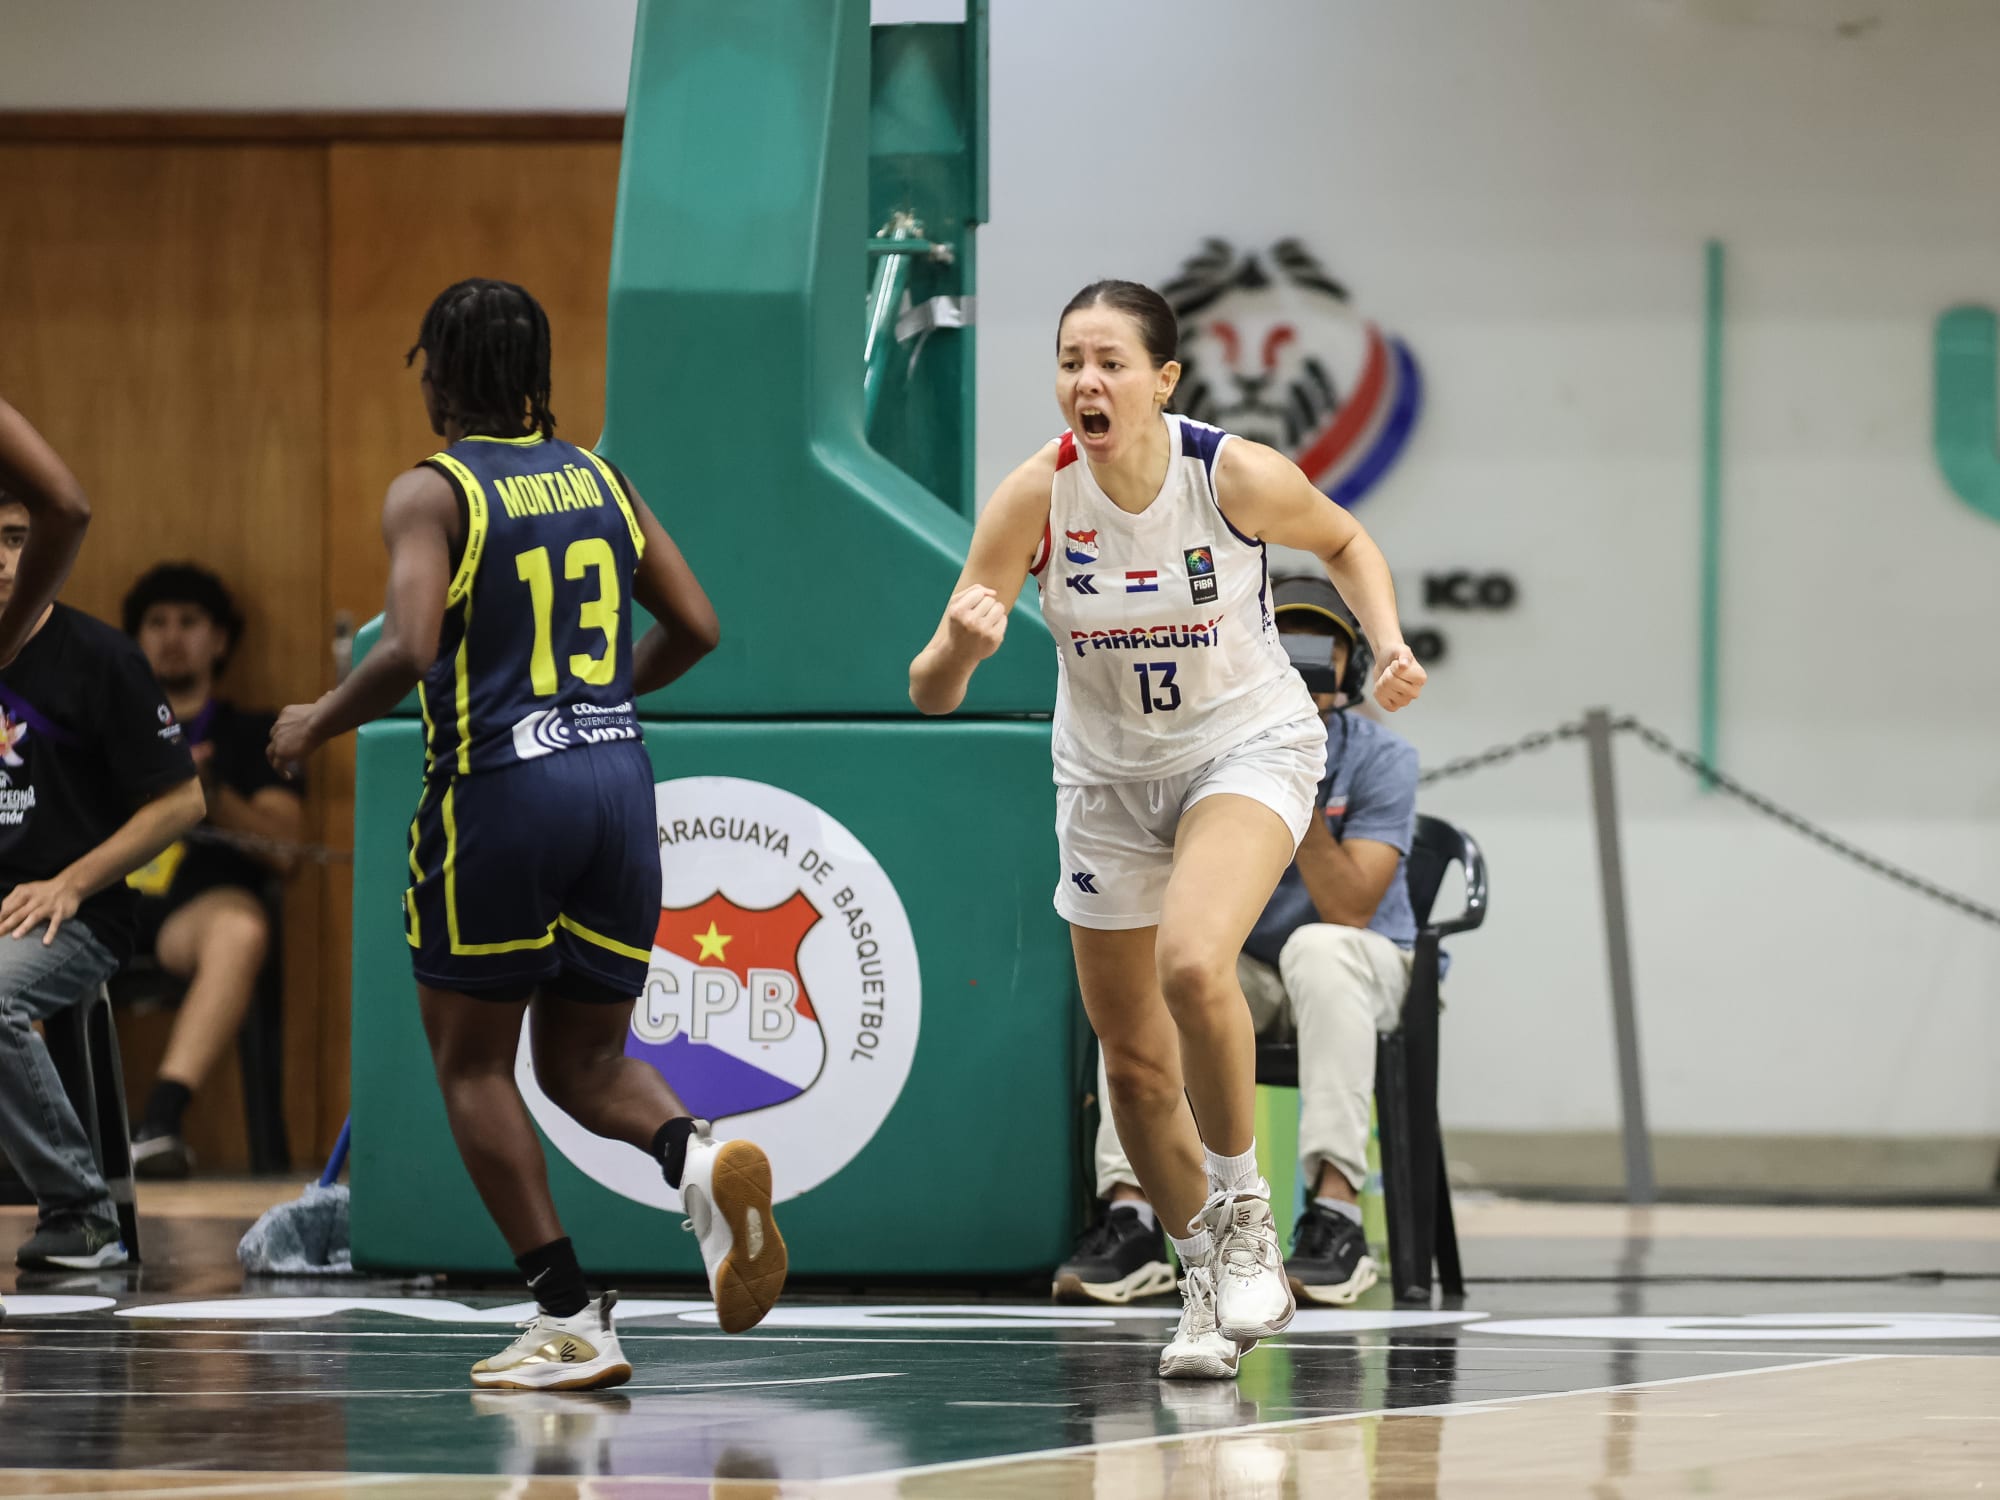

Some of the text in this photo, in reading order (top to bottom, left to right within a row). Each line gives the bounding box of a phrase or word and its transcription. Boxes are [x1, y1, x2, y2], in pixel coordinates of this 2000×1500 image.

[493, 463, 604, 519] MONTAÑO
[1194, 577, 1214, 591] FIBA
[515, 537, 620, 697] 13
[1071, 614, 1224, 657] PARAGUAY
[1133, 661, 1181, 714] 13
[798, 849, 834, 885] DE
[832, 886, 884, 1062] BASQUETBOL
[633, 968, 796, 1043] CPB
